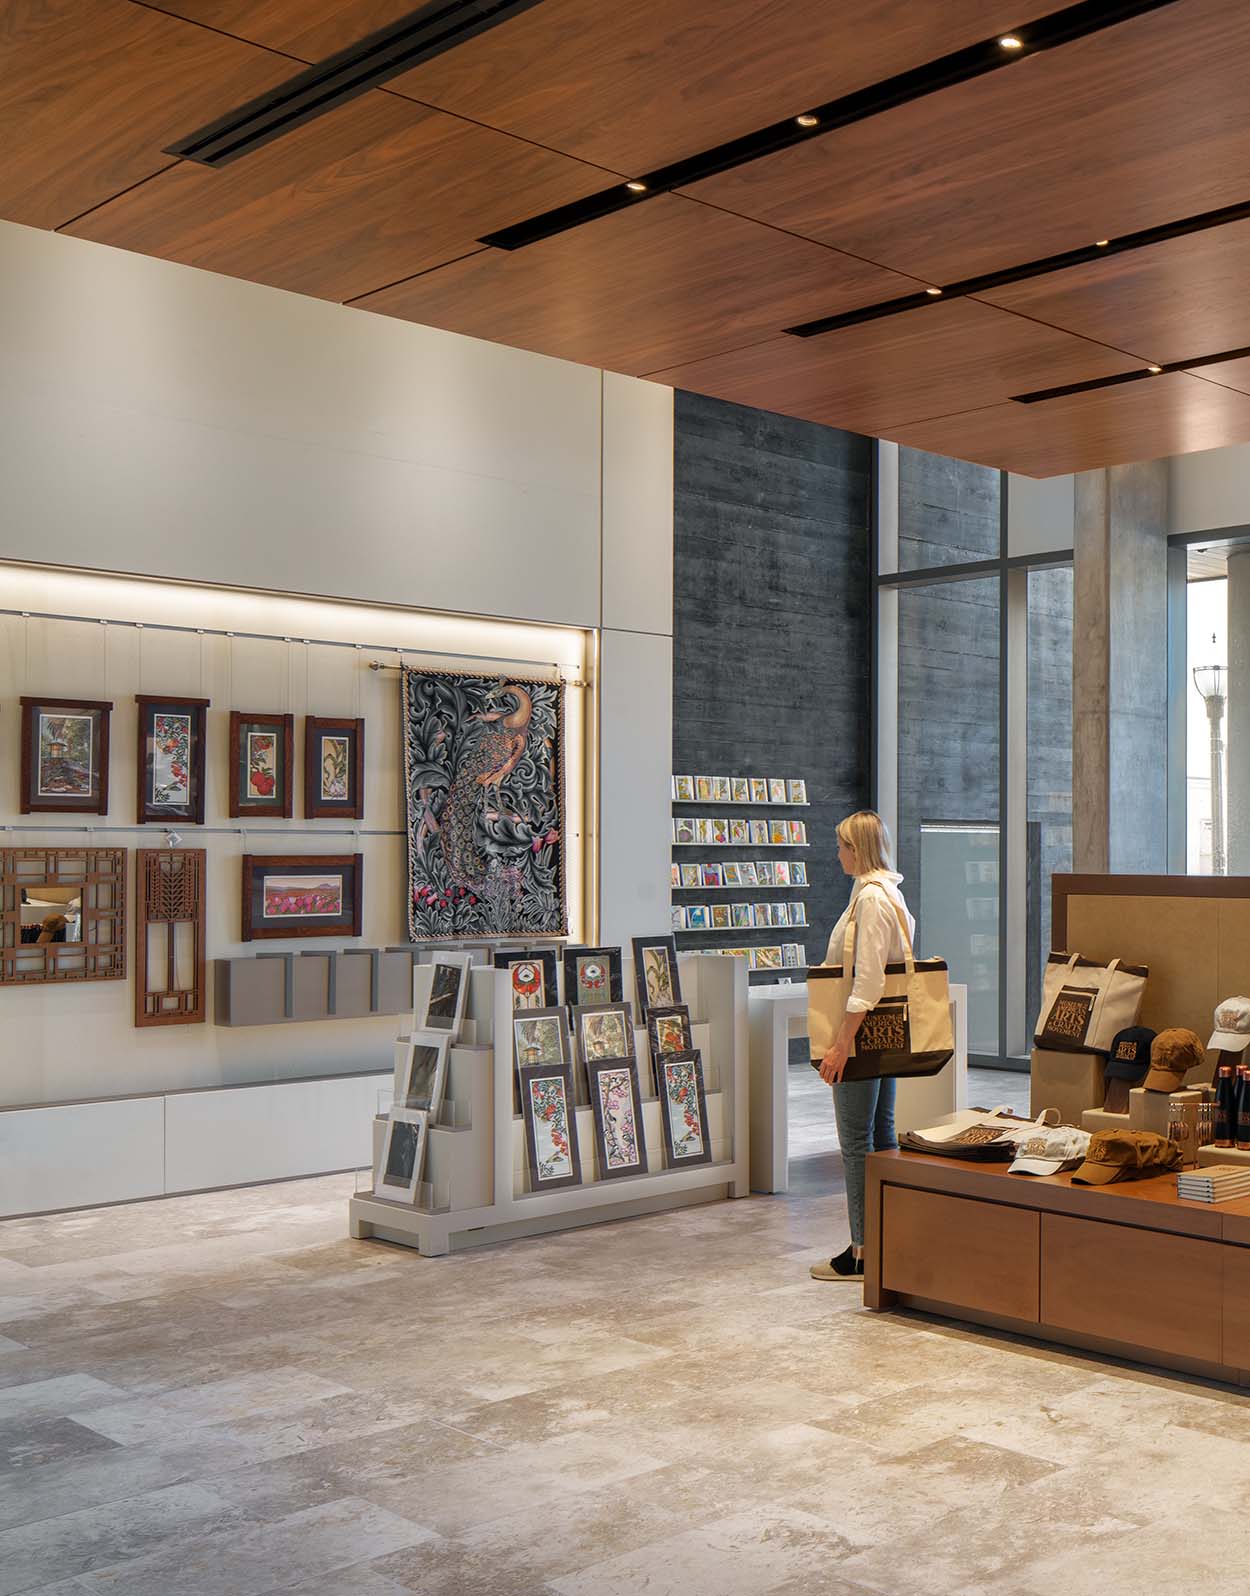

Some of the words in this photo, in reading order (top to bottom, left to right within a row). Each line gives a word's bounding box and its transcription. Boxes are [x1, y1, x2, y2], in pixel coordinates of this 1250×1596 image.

[1053, 1009, 1086, 1025] ARTS
[861, 1026, 905, 1037] ARTS
[868, 1036, 904, 1044] CRAFTS
